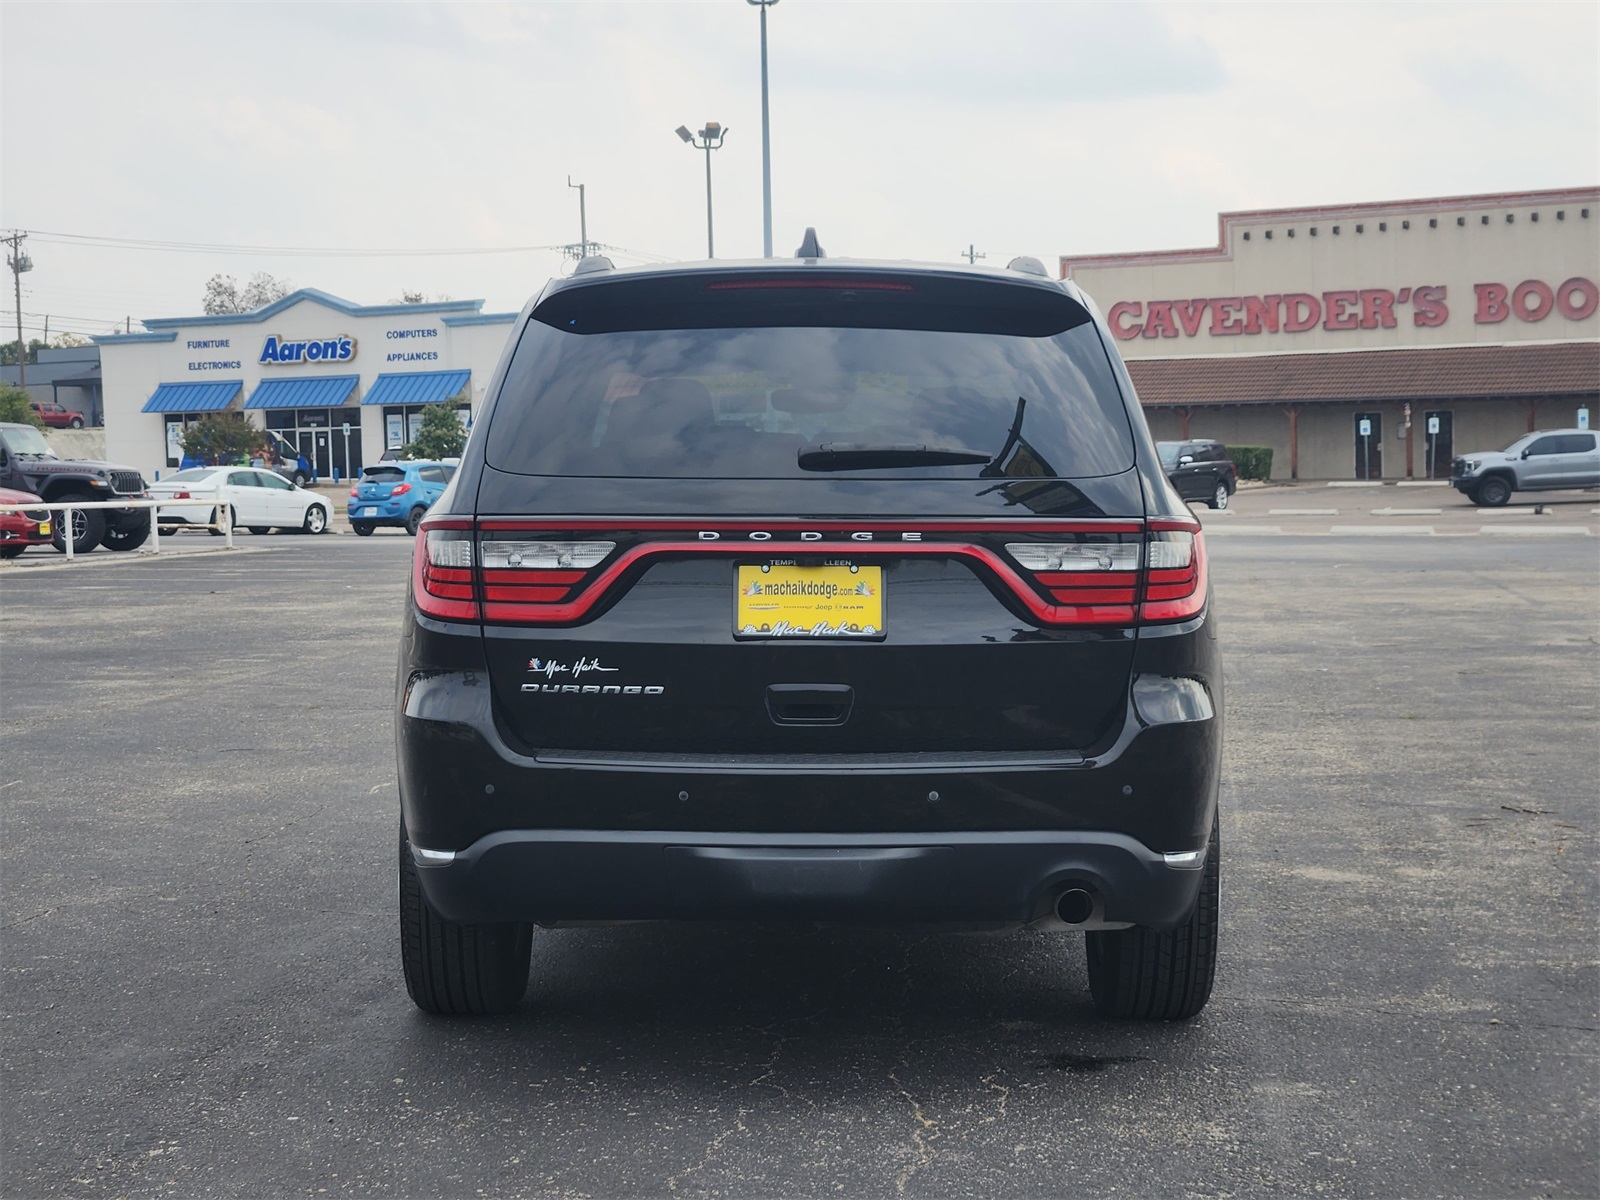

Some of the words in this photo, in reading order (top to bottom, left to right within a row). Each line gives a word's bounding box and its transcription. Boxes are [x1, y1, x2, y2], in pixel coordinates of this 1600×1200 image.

[1108, 285, 1449, 340] CAVENDER'S
[1474, 277, 1600, 324] BOO
[386, 329, 438, 339] COMPUTERS
[187, 340, 230, 349] FURNITURE
[259, 336, 353, 363] Aaron's
[387, 352, 438, 362] APPLIANCES
[188, 361, 241, 371] ELECTRONICS
[698, 531, 922, 541] DODGE
[764, 580, 854, 600] machaikdodge.com
[771, 620, 808, 637] Mac
[810, 620, 853, 637] Haik
[541, 658, 570, 679] Mac
[572, 656, 609, 678] Haik
[520, 683, 665, 694] DURANGO
